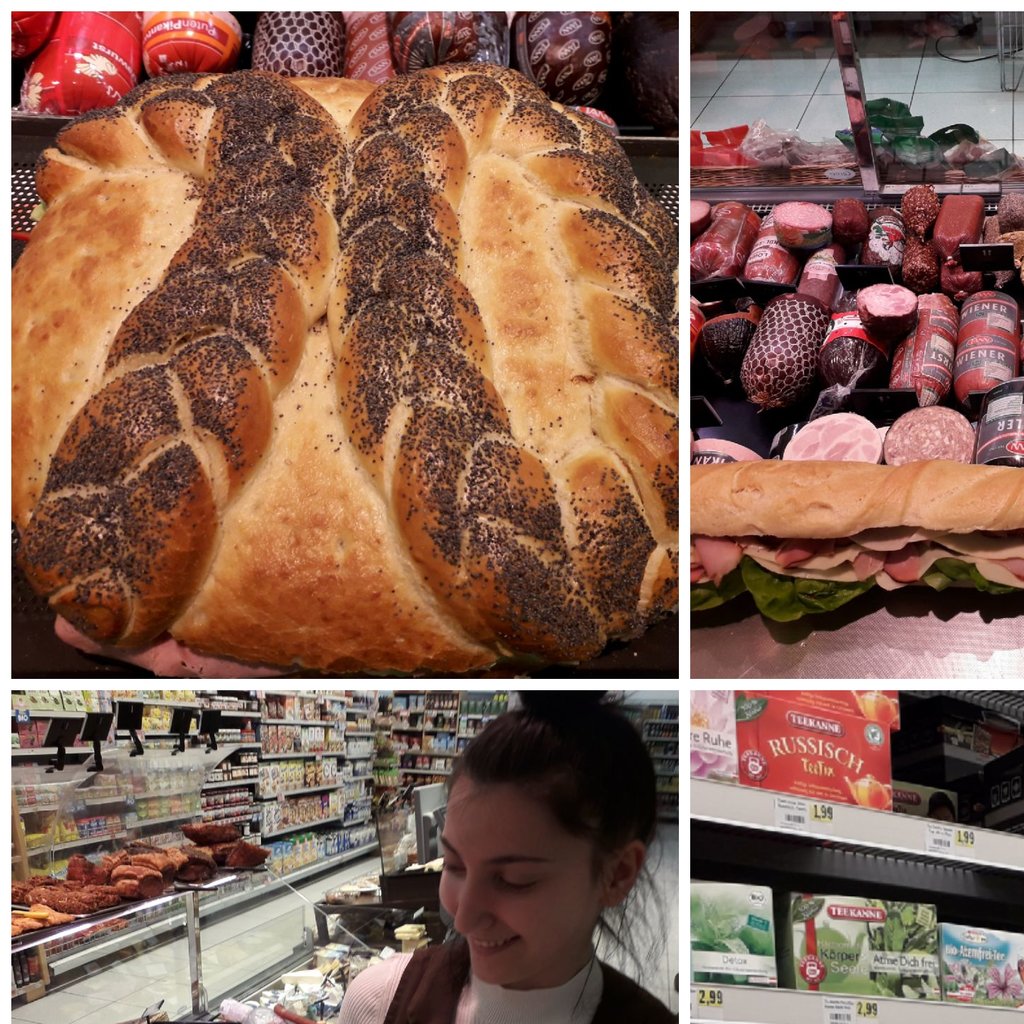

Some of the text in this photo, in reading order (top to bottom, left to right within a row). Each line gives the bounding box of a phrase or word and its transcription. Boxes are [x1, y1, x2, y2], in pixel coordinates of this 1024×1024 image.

[960, 302, 1008, 319] WIENER
[956, 350, 1006, 368] WIENER
[789, 713, 842, 733] TEEKANNE
[703, 731, 732, 749] Ruhe
[768, 736, 865, 775] RUSSISCH
[830, 906, 884, 920] TEEKANNE
[721, 955, 748, 966] Detox
[820, 947, 859, 962] Körper
[698, 989, 724, 1006] 2,99
[857, 1001, 878, 1017] 2,99
